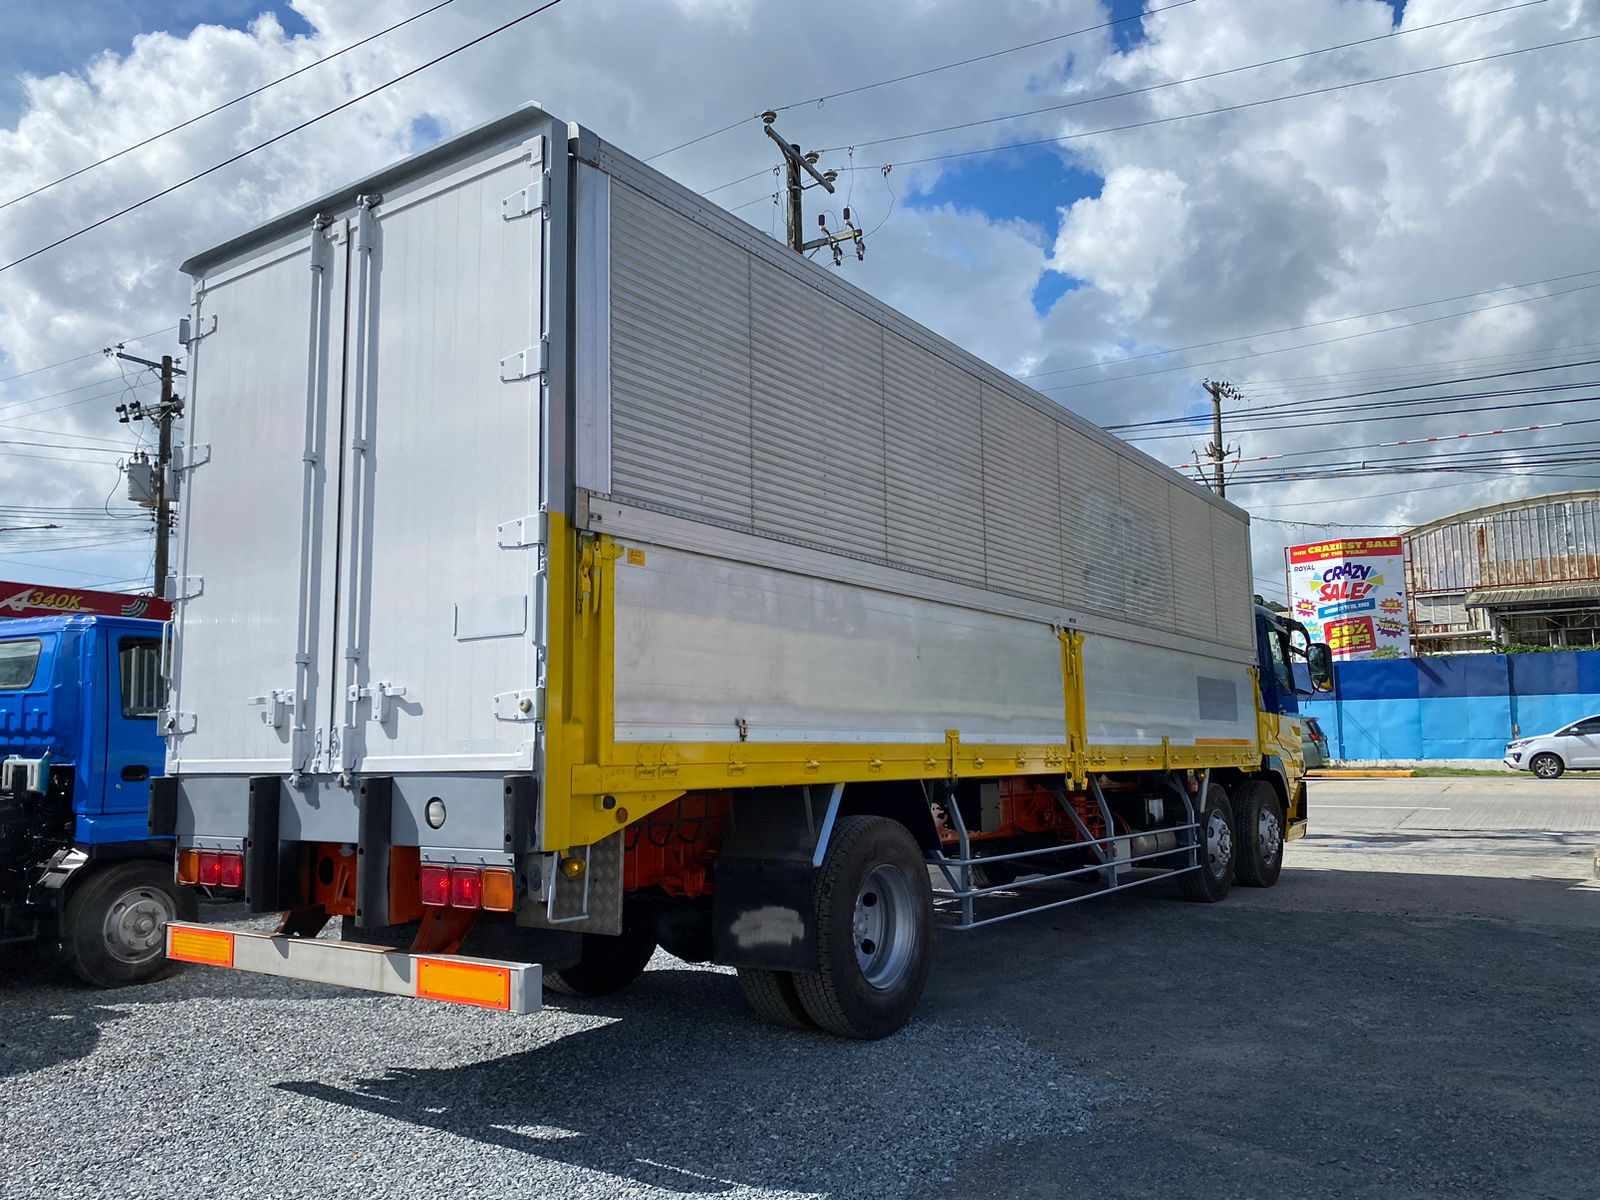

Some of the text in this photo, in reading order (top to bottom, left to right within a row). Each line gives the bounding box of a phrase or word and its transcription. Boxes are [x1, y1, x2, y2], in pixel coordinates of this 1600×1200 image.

[1366, 540, 1398, 548] SALE
[1294, 564, 1315, 572] ROYAL
[1322, 562, 1372, 583] CRAZY
[1319, 581, 1373, 602] SALE!
[1331, 623, 1368, 637] 50%
